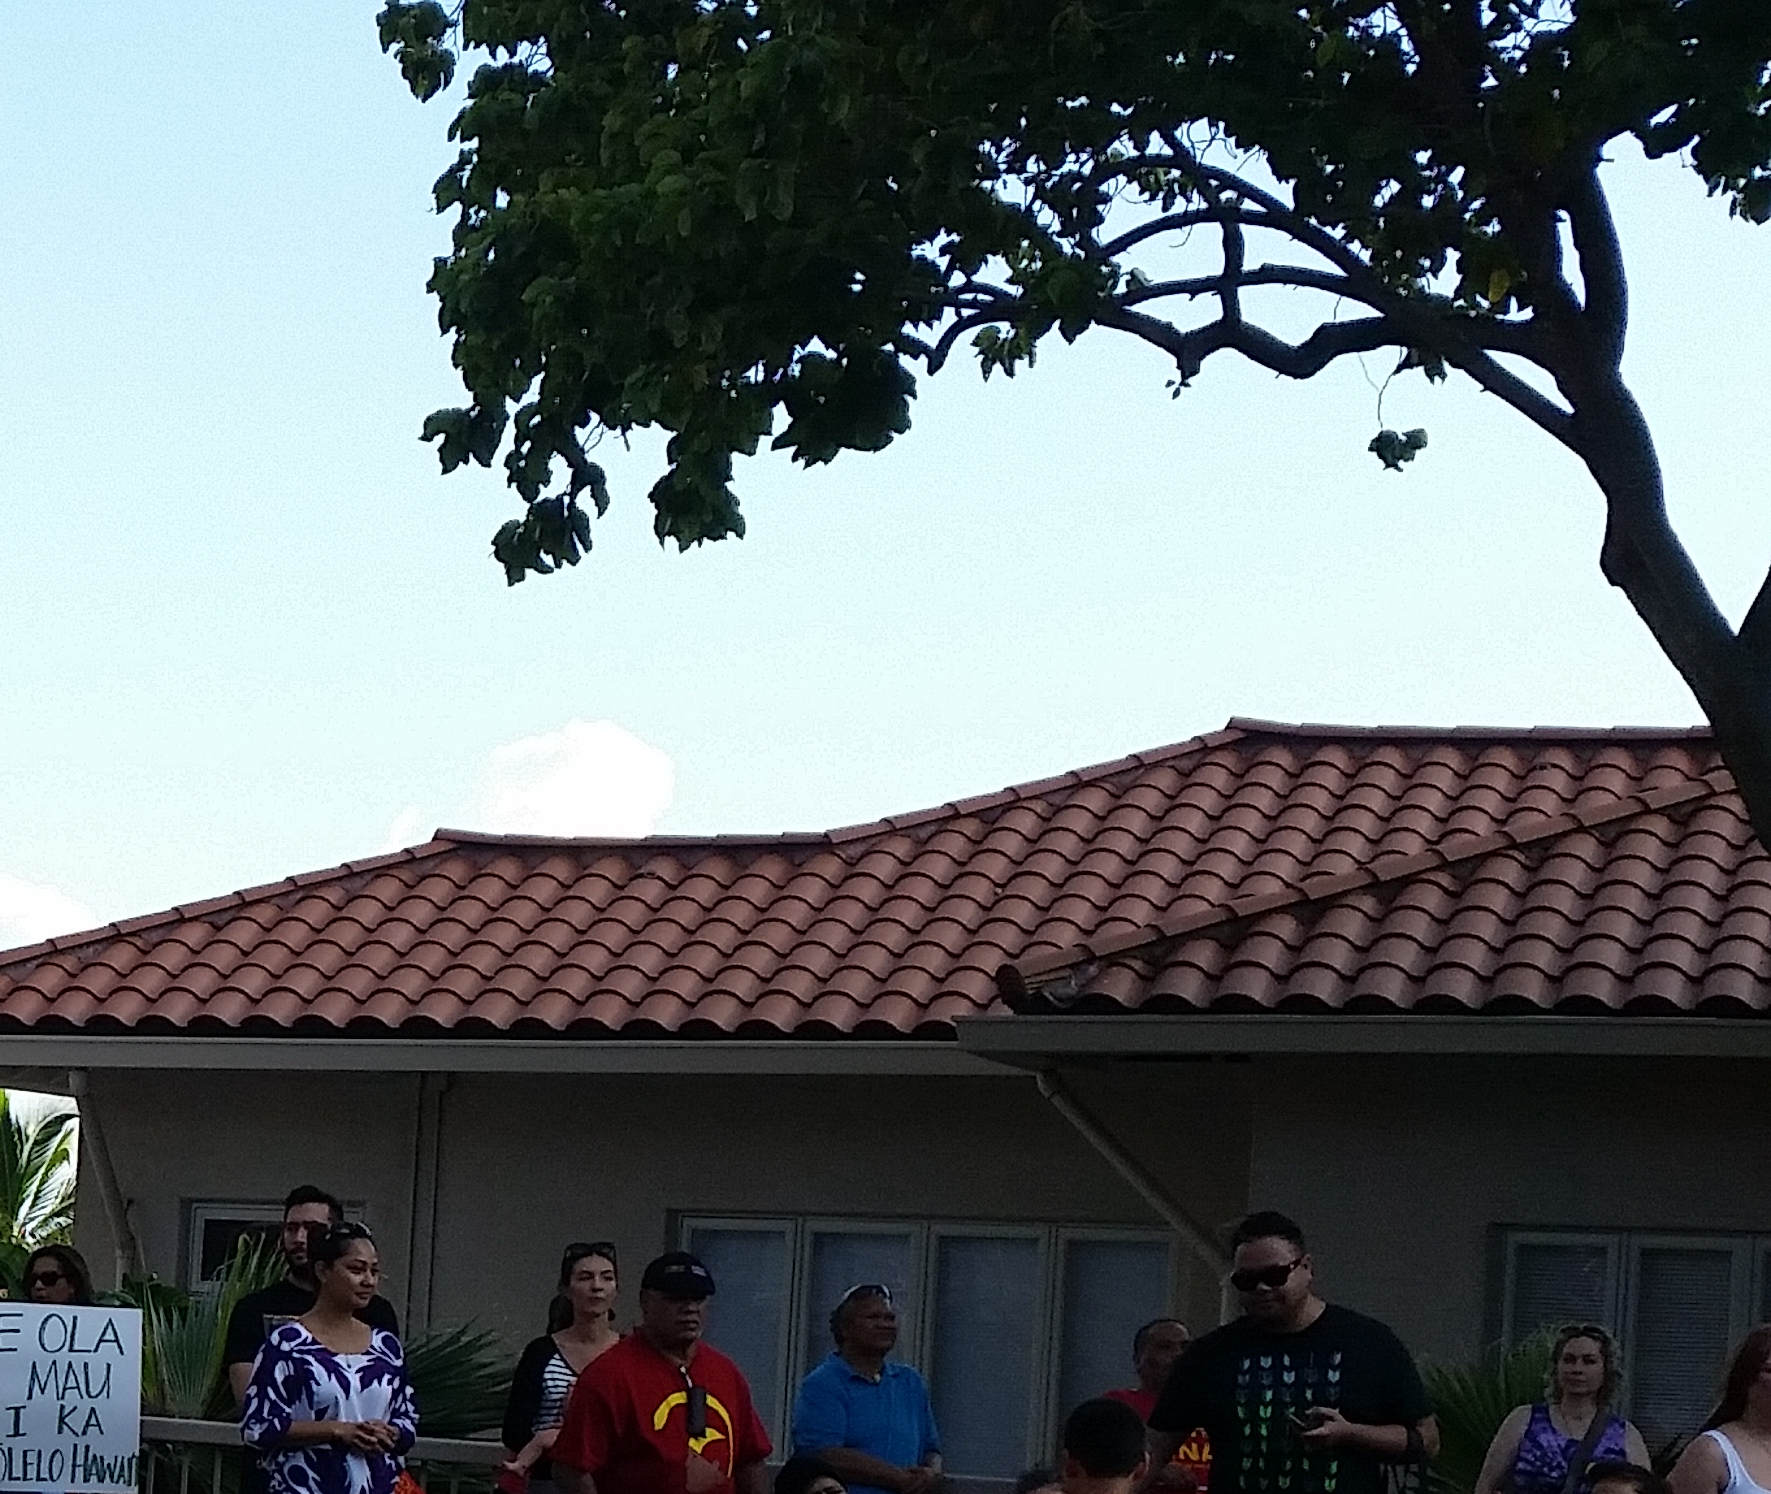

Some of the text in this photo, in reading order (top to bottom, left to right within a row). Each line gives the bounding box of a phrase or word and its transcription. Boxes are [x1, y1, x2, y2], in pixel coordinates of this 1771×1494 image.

[37, 1312, 125, 1356] OLA
[26, 1359, 112, 1401] MAU
[5, 1404, 105, 1438] I KA
